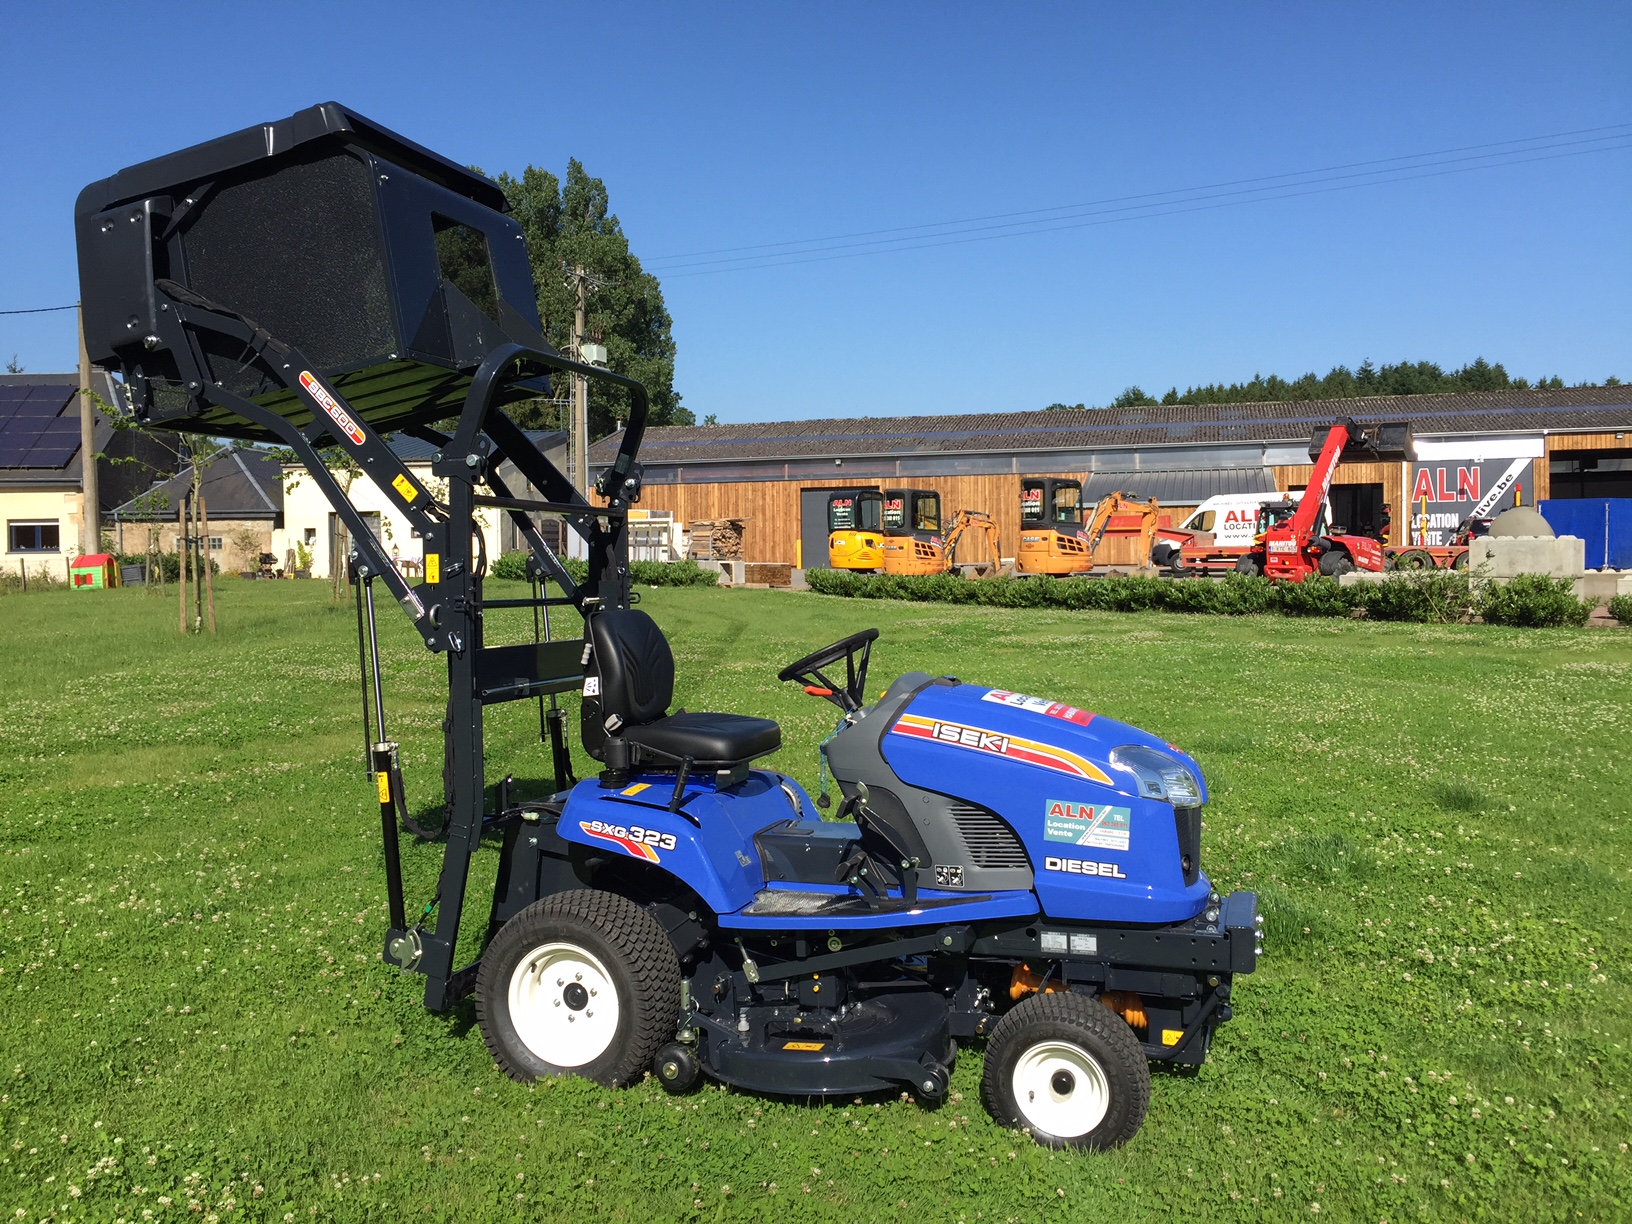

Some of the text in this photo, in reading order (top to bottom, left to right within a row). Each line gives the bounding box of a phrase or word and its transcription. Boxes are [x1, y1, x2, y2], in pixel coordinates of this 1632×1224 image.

[1412, 466, 1481, 503] ALN
[1223, 523, 1257, 531] LOCATI
[932, 722, 1010, 754] ISEKI
[1049, 802, 1095, 821] ALN
[1113, 814, 1125, 822] TEL
[1047, 819, 1086, 831] Location
[1047, 828, 1074, 838] Vente
[1044, 855, 1128, 879] DIESEL
